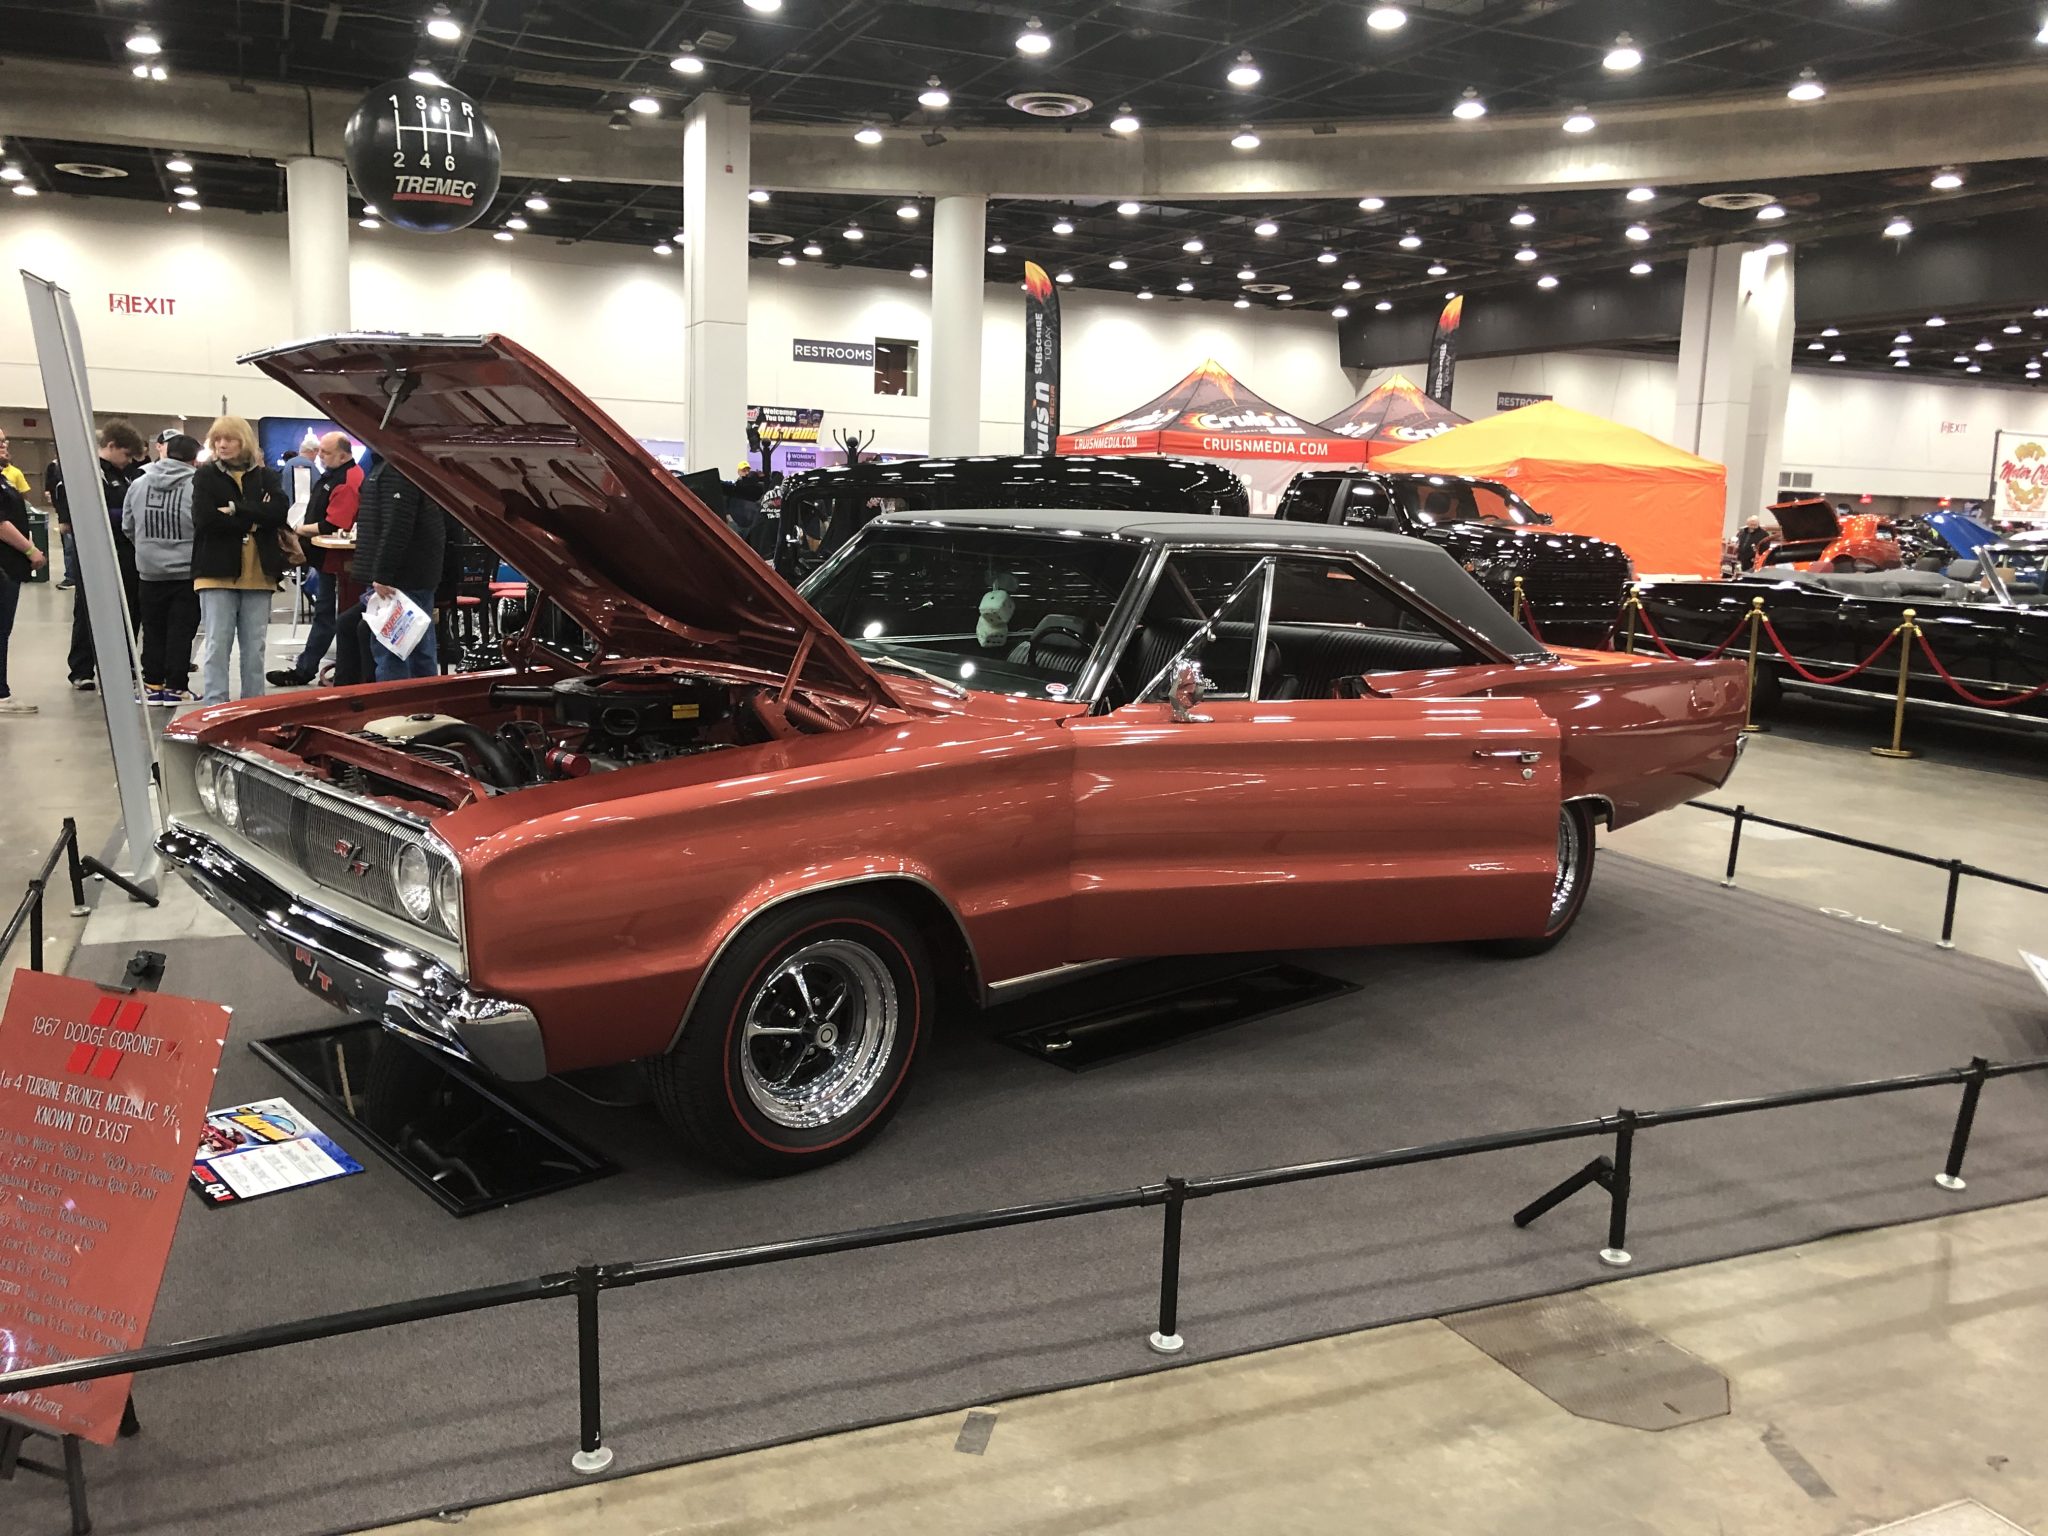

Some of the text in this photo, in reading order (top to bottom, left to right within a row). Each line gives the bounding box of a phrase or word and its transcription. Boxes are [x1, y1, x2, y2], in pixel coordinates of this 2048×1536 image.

[389, 95, 474, 117] 1 3 5 R
[393, 152, 455, 171] 2 4 6
[395, 175, 476, 199] TREMEC
[131, 296, 176, 315] EXIT
[794, 345, 873, 361] RESTROOMS
[1034, 313, 1043, 374] SUBSCRIBE
[1044, 326, 1053, 361] TODAY
[763, 407, 797, 416] Welcomes
[1074, 436, 1138, 450] CRUISNMEDIA.COM
[1203, 437, 1328, 456] CRUISNMEDIA.COM
[2000, 460, 2031, 482] Motor
[32, 1015, 60, 1037] 1967
[64, 1021, 108, 1047] DODGE
[109, 1030, 164, 1057] CORONET
[13, 1074, 24, 1092] 4
[24, 1074, 64, 1101] TURBINE
[64, 1083, 104, 1111] BRONZE
[105, 1093, 158, 1122] METALLIC
[33, 1105, 133, 1144] KNOWN TO EXIST
[32, 1178, 62, 1200] EXPORT
[130, 1181, 160, 1200] PLANT
